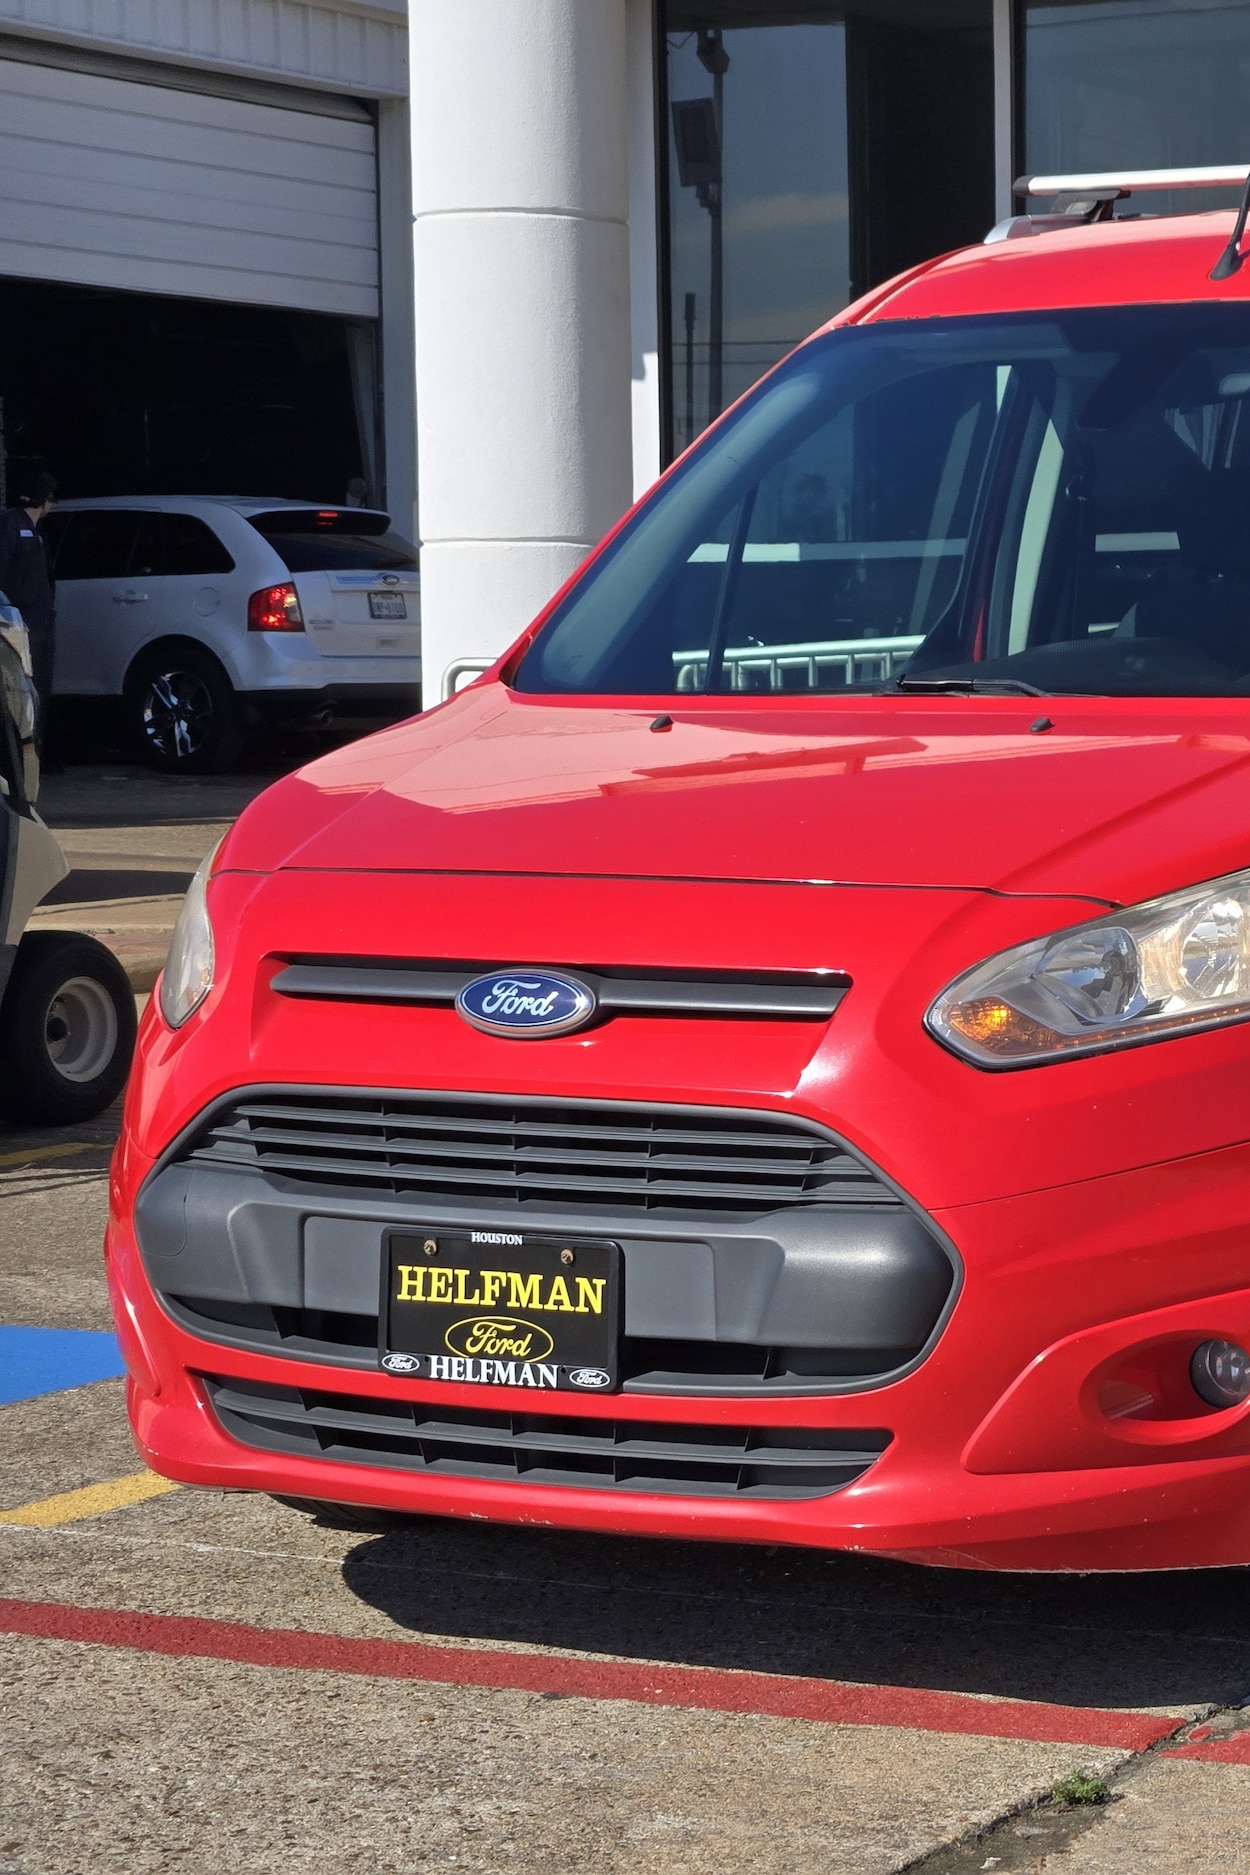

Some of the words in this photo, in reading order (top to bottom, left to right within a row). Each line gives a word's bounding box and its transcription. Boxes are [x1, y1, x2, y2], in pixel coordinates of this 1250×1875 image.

[481, 979, 559, 1016] Ford
[471, 1231, 523, 1246] HOUSTON
[397, 1265, 606, 1314] HELFMAN
[466, 1320, 533, 1357] Ford
[388, 1356, 414, 1371] Ford
[430, 1355, 559, 1388] HELFMAN
[576, 1370, 603, 1386] Ford
